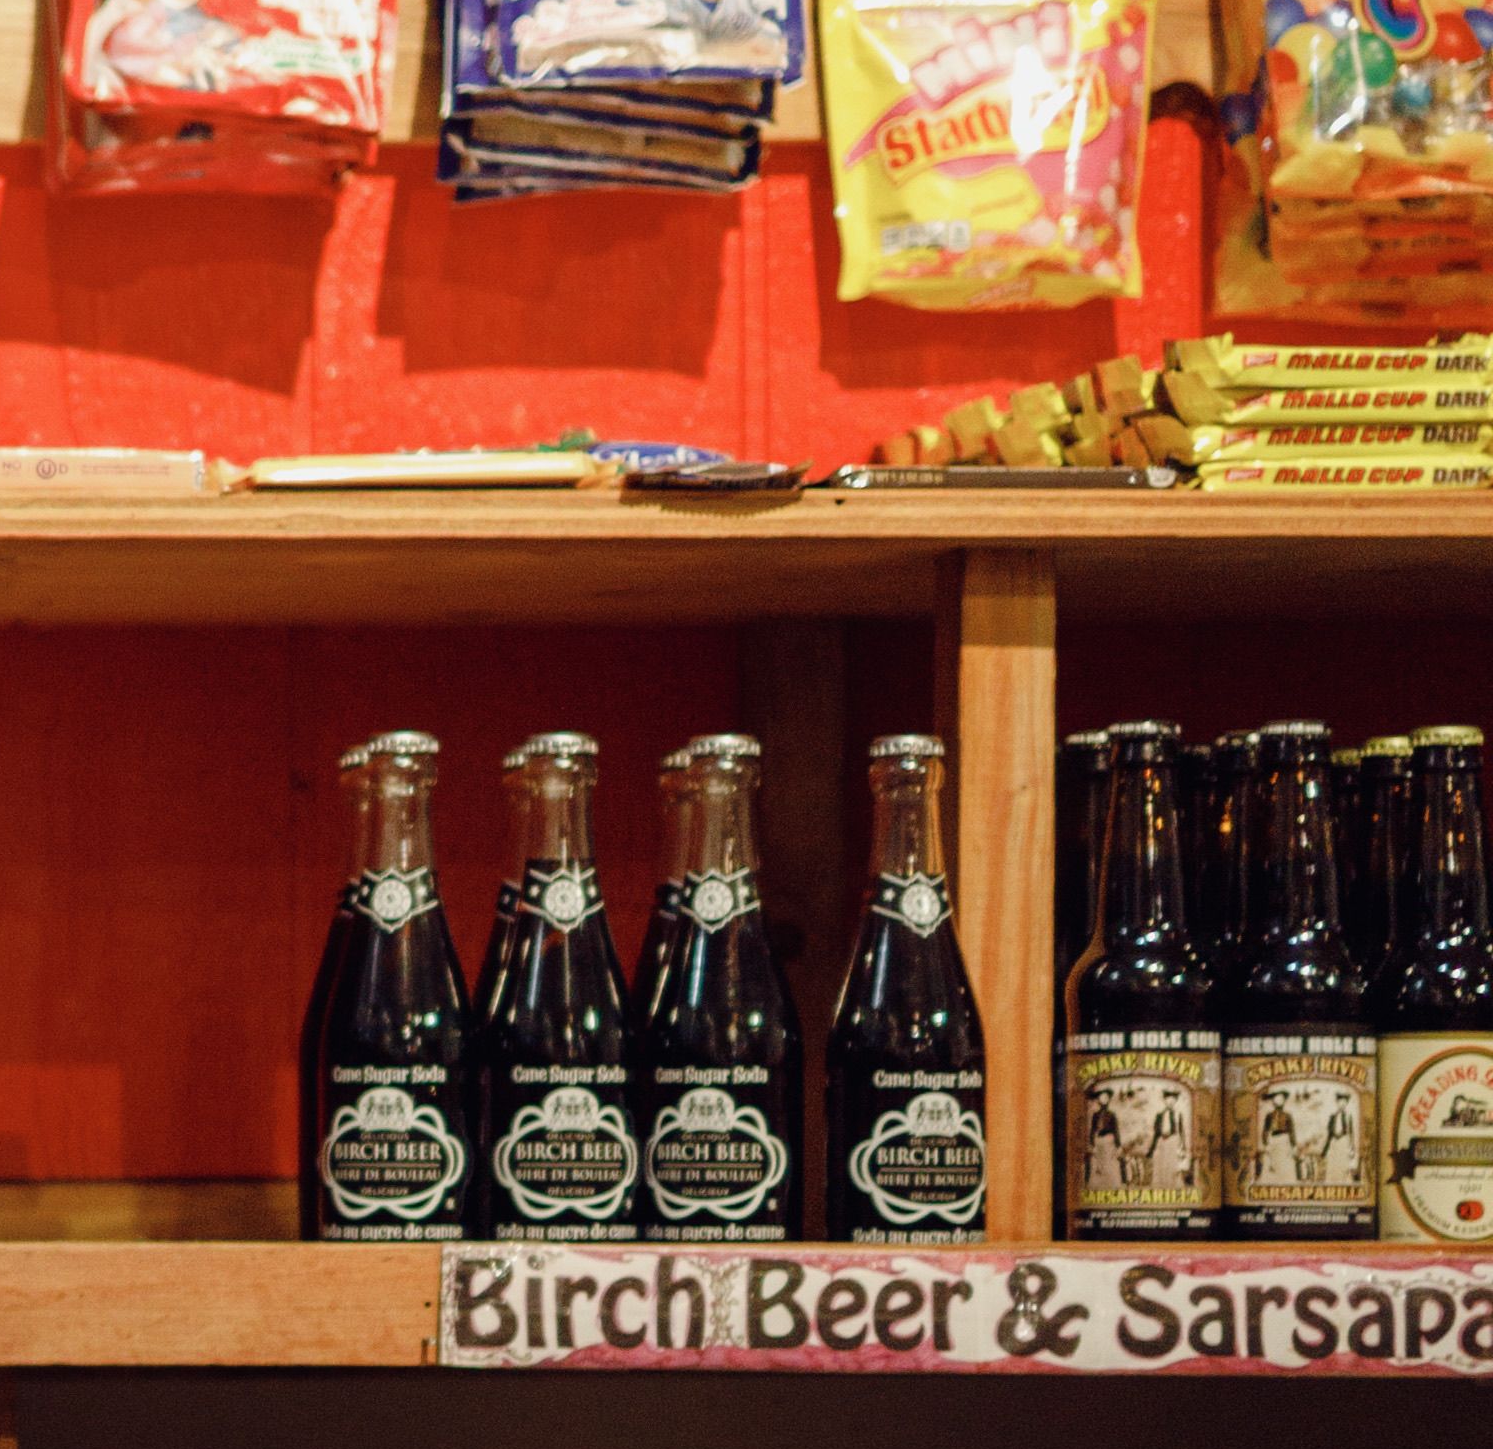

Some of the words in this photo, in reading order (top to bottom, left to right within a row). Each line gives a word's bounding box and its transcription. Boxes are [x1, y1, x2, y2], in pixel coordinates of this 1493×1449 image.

[1287, 353, 1372, 370] MALLO
[1375, 354, 1428, 370] CUP
[1435, 354, 1488, 371] DARK
[1281, 390, 1370, 409] MALLO
[1373, 392, 1428, 409] CUP
[1435, 391, 1490, 408] DARK
[1268, 426, 1357, 445] MALLO
[1360, 427, 1414, 445] CUP
[1422, 425, 1479, 443] DARK
[1274, 467, 1364, 485] MALLO
[1368, 468, 1424, 484] CUP
[1433, 468, 1491, 485] DARK
[1131, 1031, 1182, 1050] HOLE
[1226, 1036, 1303, 1055] JACKSON
[1308, 1036, 1354, 1055] HOLE
[332, 1065, 362, 1083] Cane
[364, 1065, 410, 1086] Sugar
[413, 1064, 447, 1083] Soda
[513, 1065, 547, 1083] Cane
[549, 1064, 593, 1086] Sugar
[596, 1064, 626, 1082] Soda
[656, 1067, 683, 1084] Cane
[684, 1066, 729, 1087] Sugar
[732, 1065, 768, 1084] Soda
[1080, 1053, 1138, 1081] SNAKE
[1144, 1053, 1202, 1081] RIVER
[1247, 1057, 1311, 1086] SNAKE
[1317, 1057, 1368, 1086] RIVER
[873, 1070, 911, 1089] Cane
[913, 1070, 957, 1091] Sugar
[1408, 1062, 1479, 1132] READING
[334, 1142, 390, 1160] BIRCH
[394, 1142, 442, 1160] BEER
[515, 1142, 579, 1160] BIRCH
[583, 1142, 623, 1160] BEER
[657, 1142, 710, 1161] BIRCH
[716, 1142, 763, 1161] BEER
[876, 1147, 939, 1166] BIRCH
[944, 1147, 981, 1166] BEER
[1080, 1186, 1202, 1206] SARSAPARILLA
[1250, 1185, 1367, 1203] SARSAPARILLA
[452, 1257, 707, 1351] Birch
[746, 1258, 975, 1351] Beer
[996, 1261, 1091, 1358] &
[1116, 1263, 1493, 1359] Sarsapa
